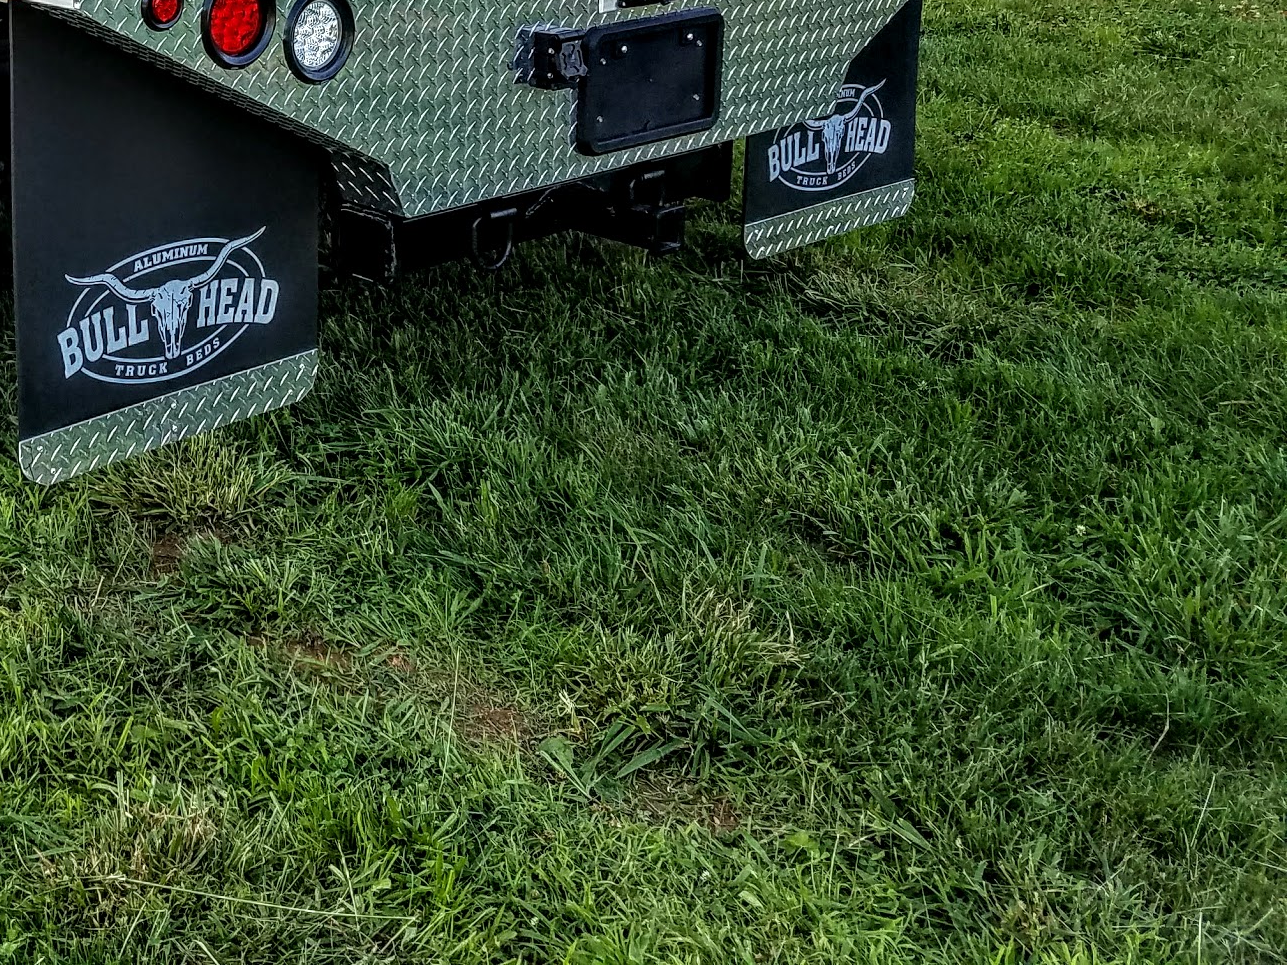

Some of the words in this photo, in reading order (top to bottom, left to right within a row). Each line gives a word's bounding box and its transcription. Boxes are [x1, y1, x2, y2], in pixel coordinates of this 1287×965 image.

[767, 130, 820, 183] BULL
[844, 117, 892, 154] HEAD
[796, 175, 829, 186] TRUCK
[837, 160, 856, 181] BEDS
[133, 243, 209, 273] ALUMINUM
[57, 303, 150, 379] BULL
[196, 277, 279, 329] HEAD
[115, 361, 168, 377] TRUCK
[186, 337, 221, 367] BEDS
